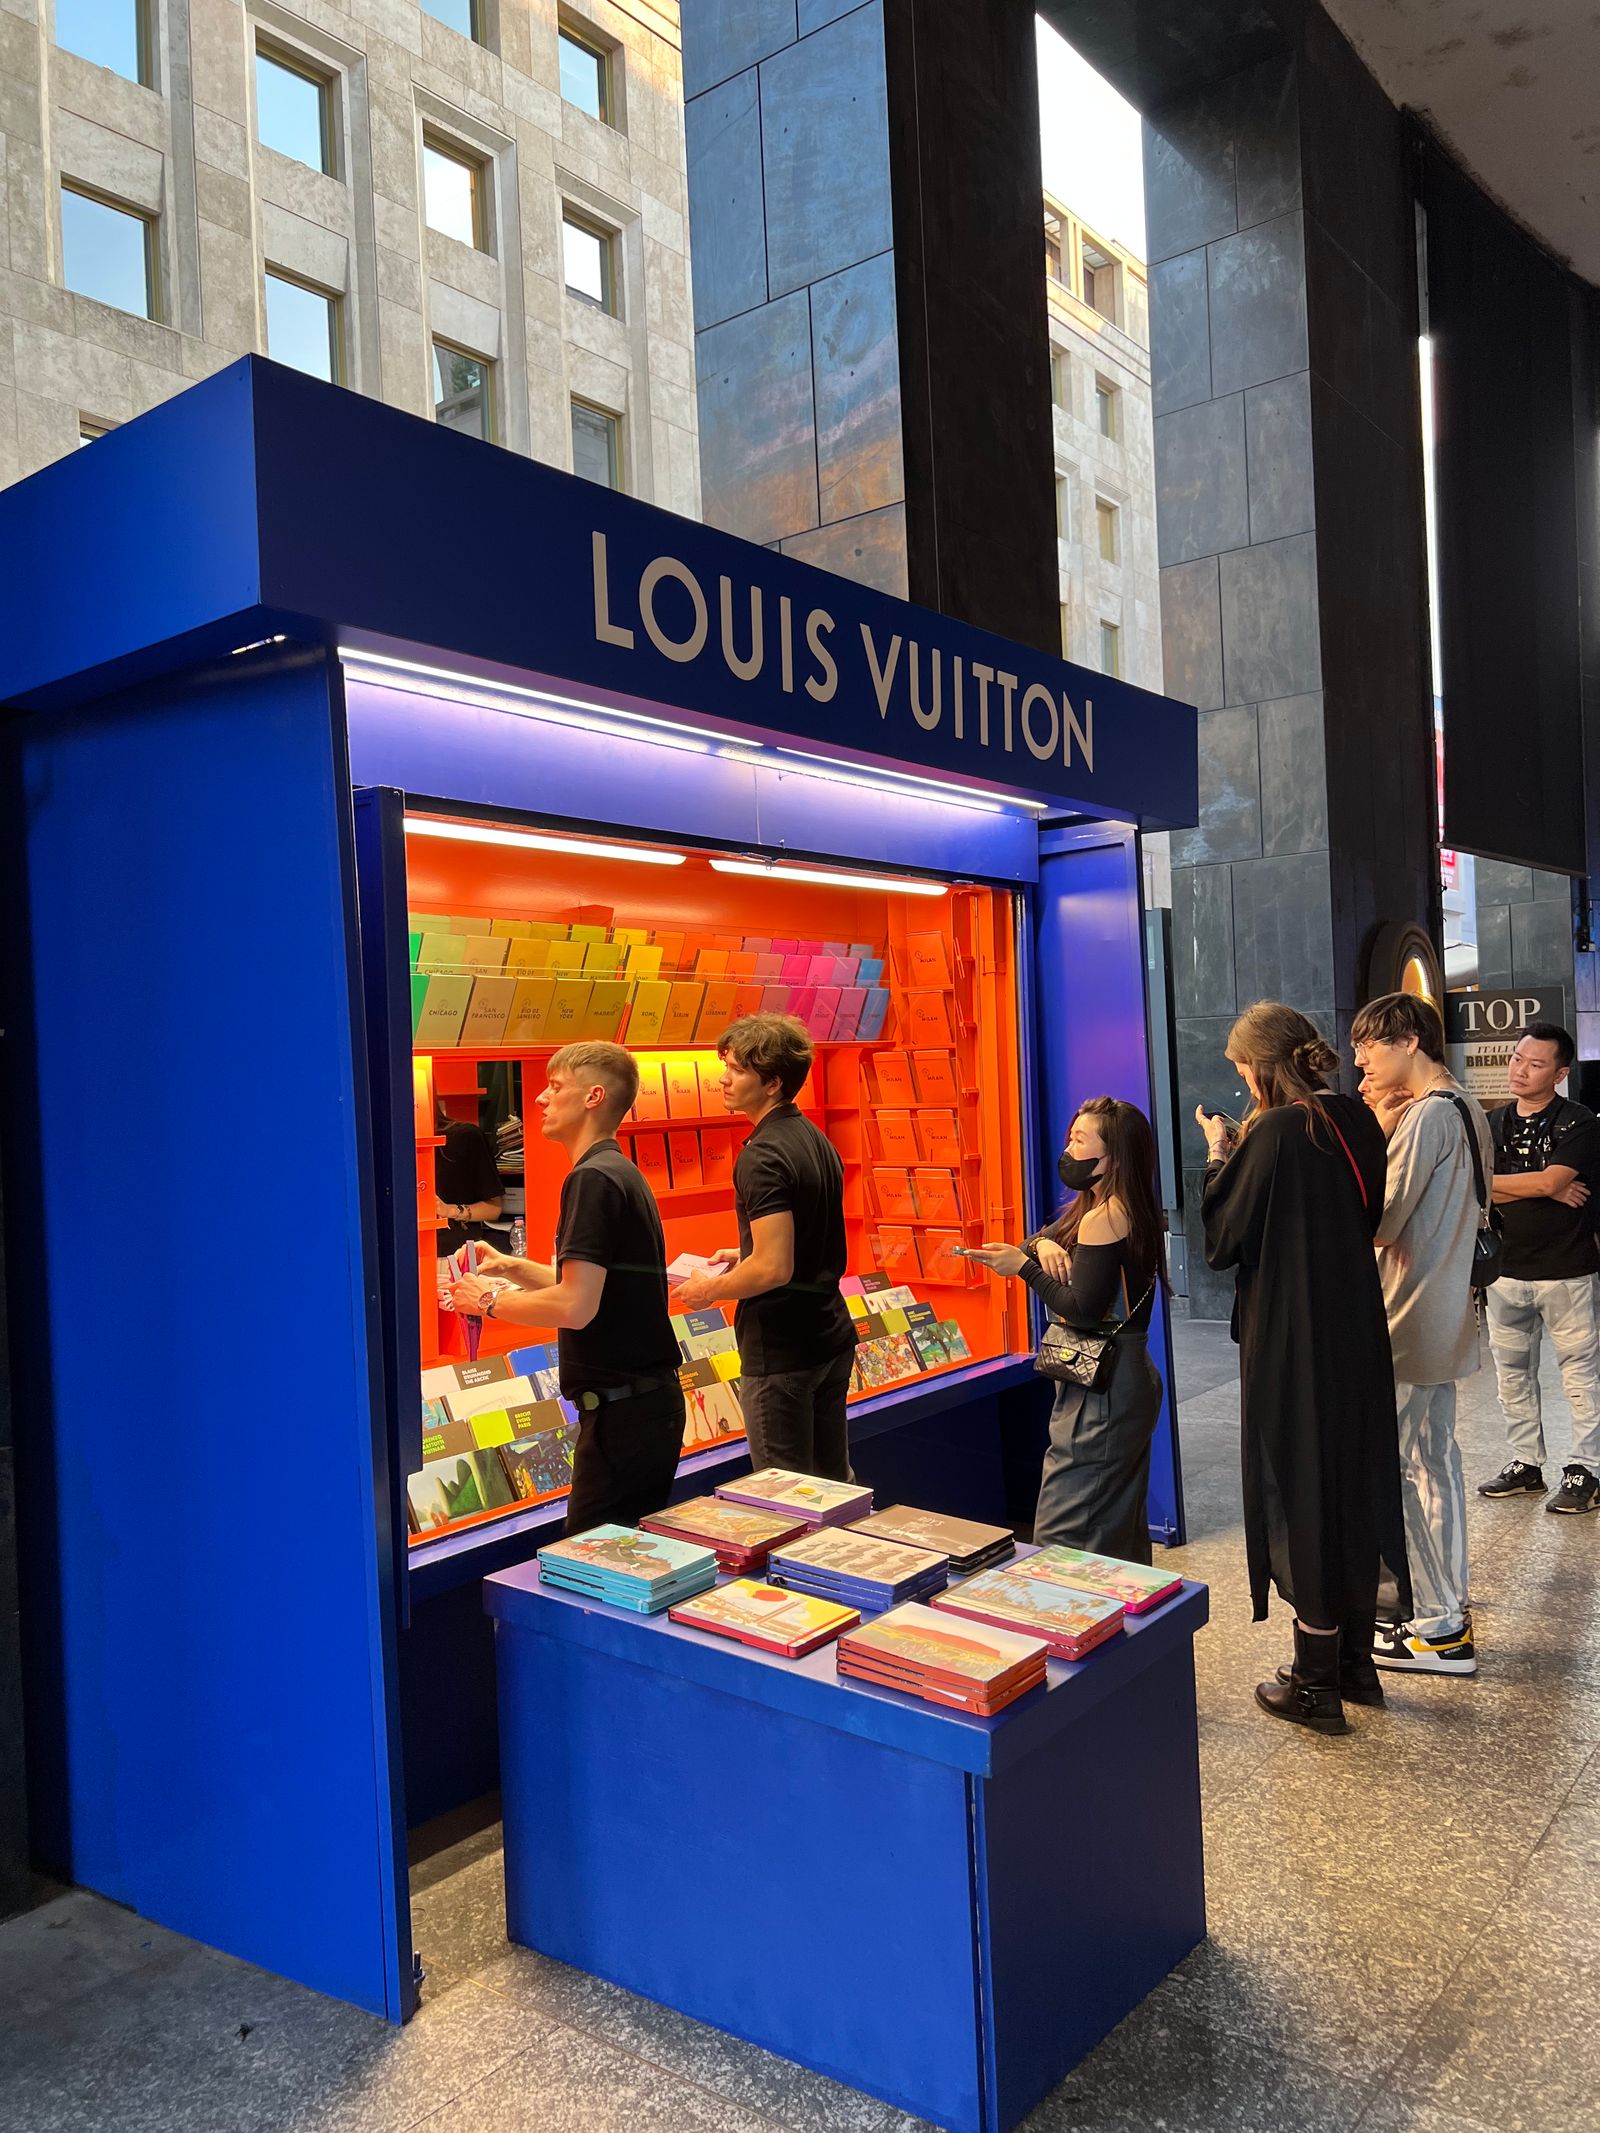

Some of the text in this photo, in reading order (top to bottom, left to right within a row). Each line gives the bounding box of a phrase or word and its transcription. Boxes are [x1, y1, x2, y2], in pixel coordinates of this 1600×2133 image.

[592, 531, 1094, 773] LOUIS VUITTON
[1458, 998, 1540, 1031] TOP
